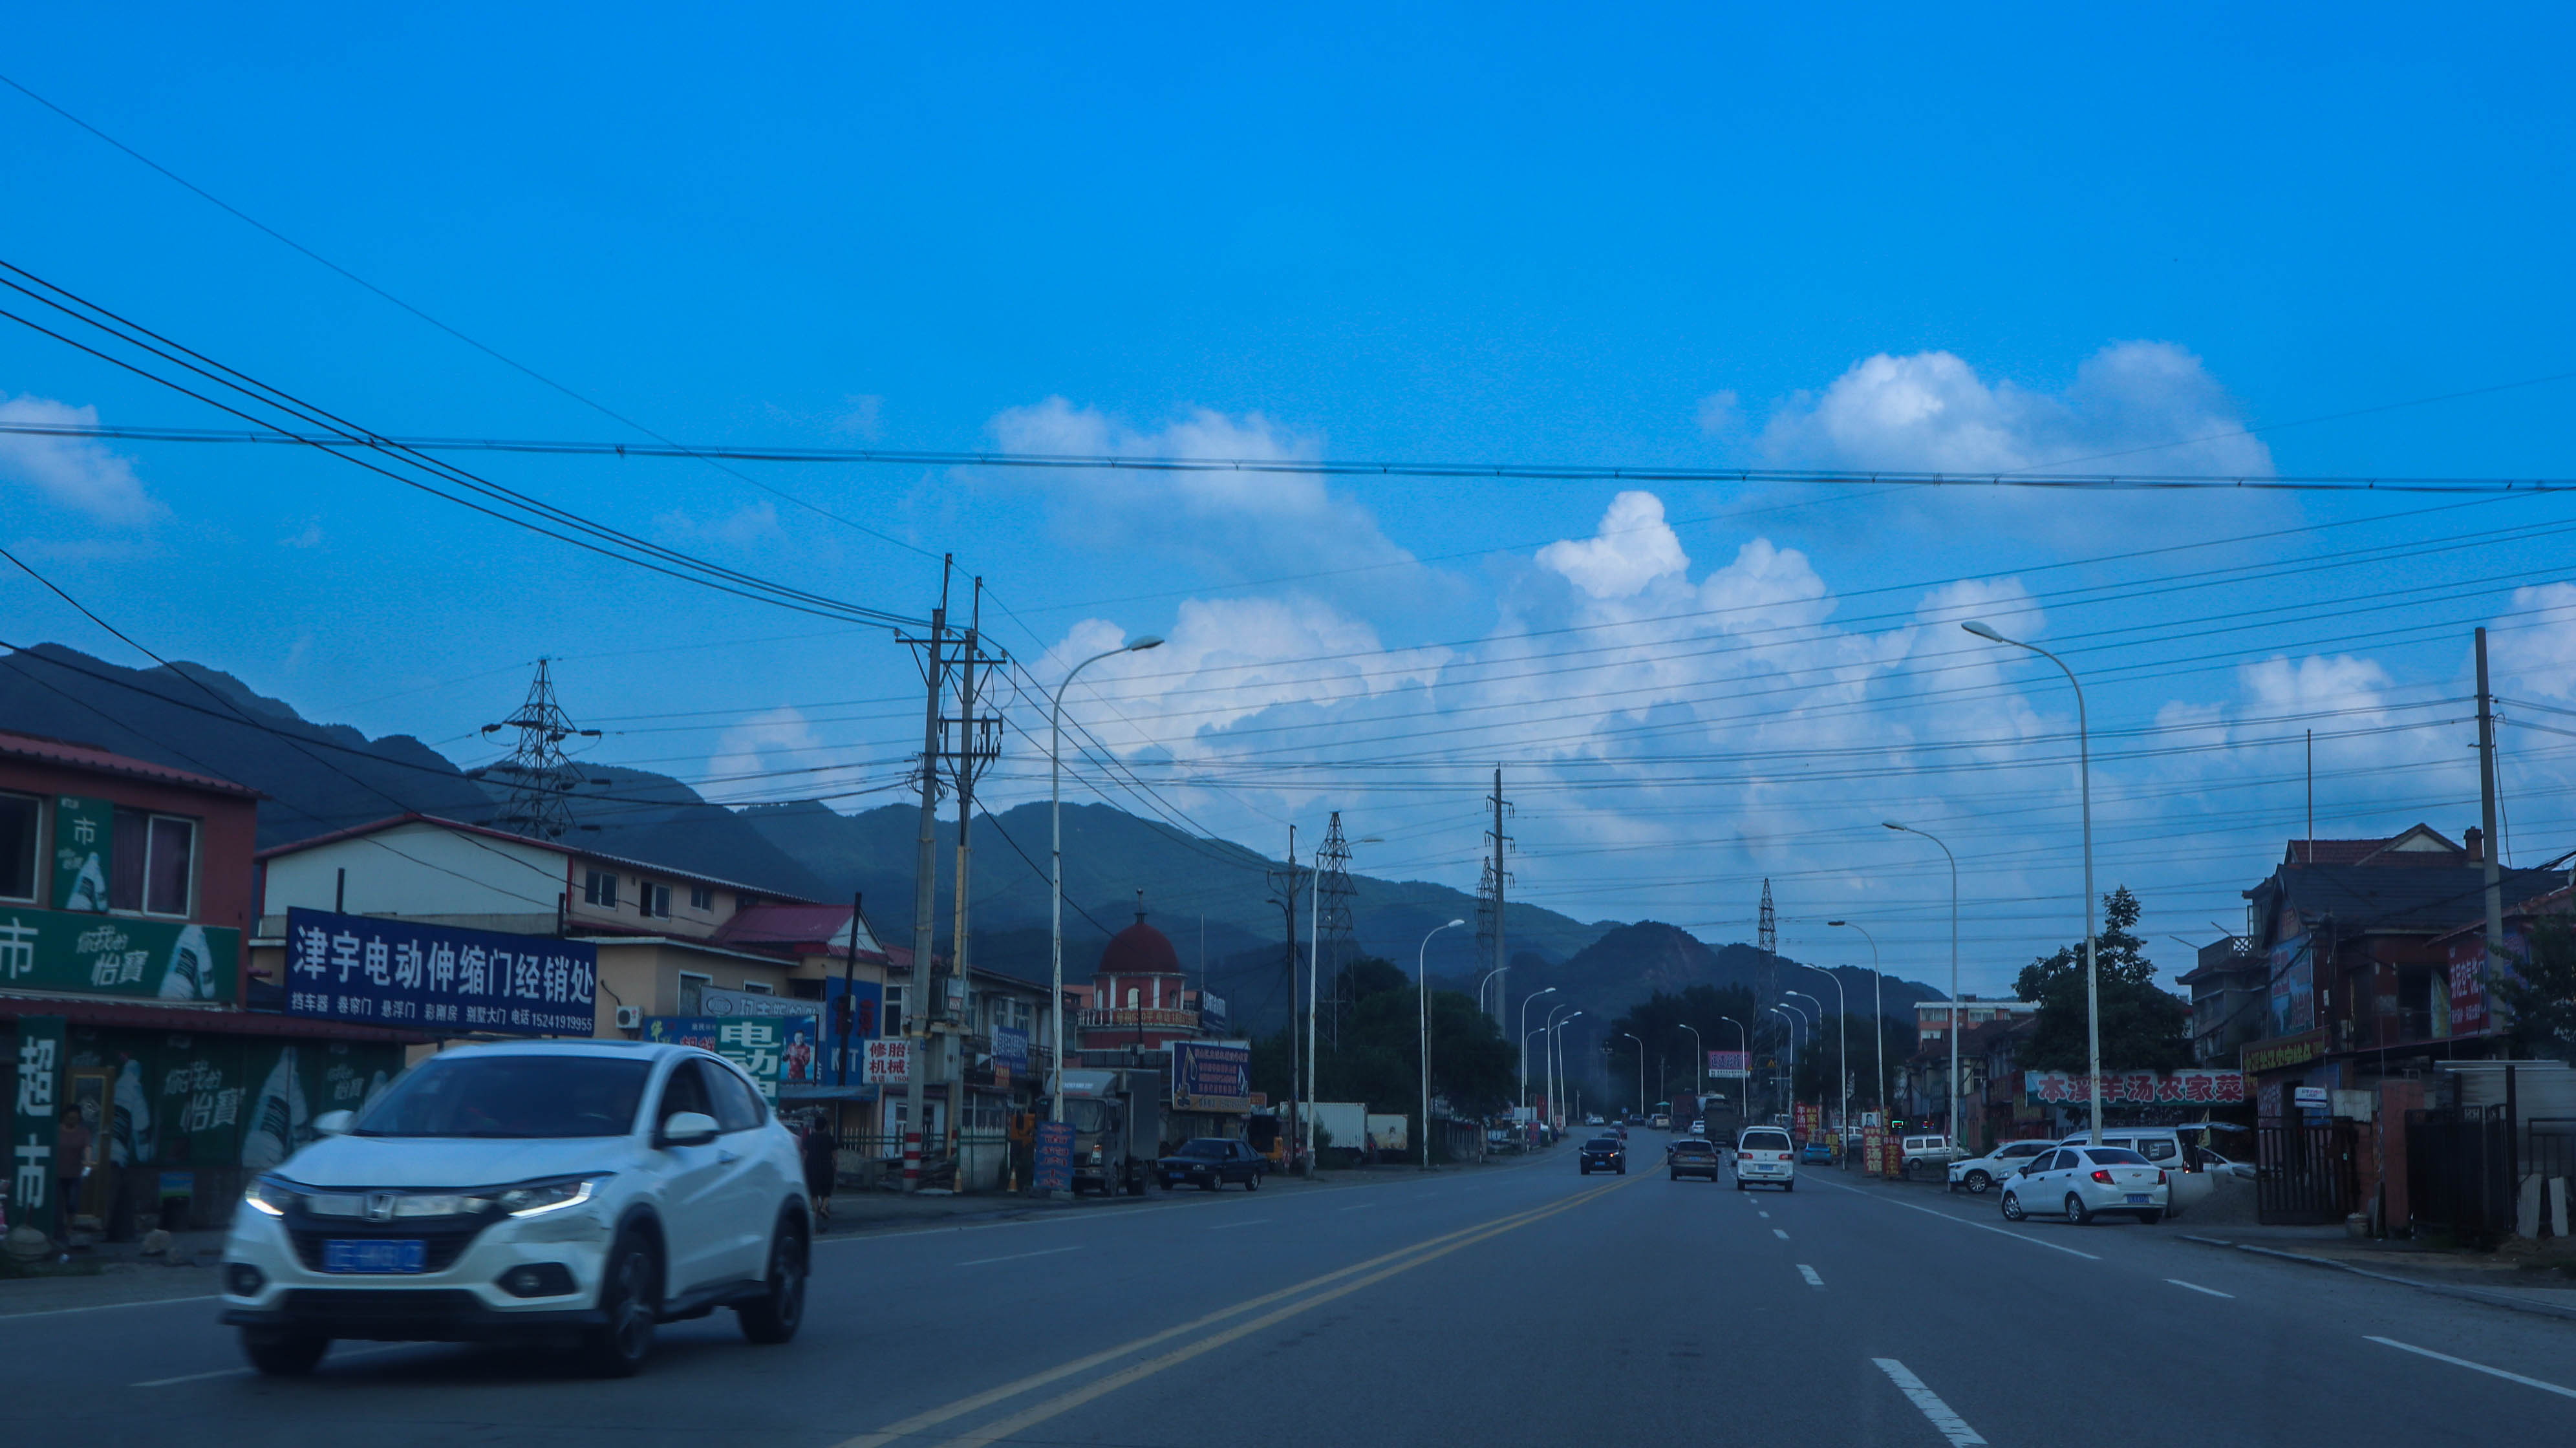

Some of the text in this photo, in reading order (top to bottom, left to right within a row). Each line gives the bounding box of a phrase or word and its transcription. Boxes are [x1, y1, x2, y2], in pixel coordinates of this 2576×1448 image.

[73, 816, 96, 846] 市
[0, 917, 39, 979] 市
[293, 925, 594, 1005] 津宇电动伸缩门经销处
[292, 991, 328, 1013] 挡车器
[336, 995, 372, 1016] 卷帘门
[381, 999, 415, 1019] 悬浮门
[466, 1005, 506, 1026] 别墅大门
[511, 1008, 530, 1027] 电话
[869, 1042, 910, 1058] 修胎
[869, 1059, 910, 1074] 机械
[2037, 1074, 2244, 1103] 本溪羊汤农家菜
[15, 1038, 54, 1209] 超市
